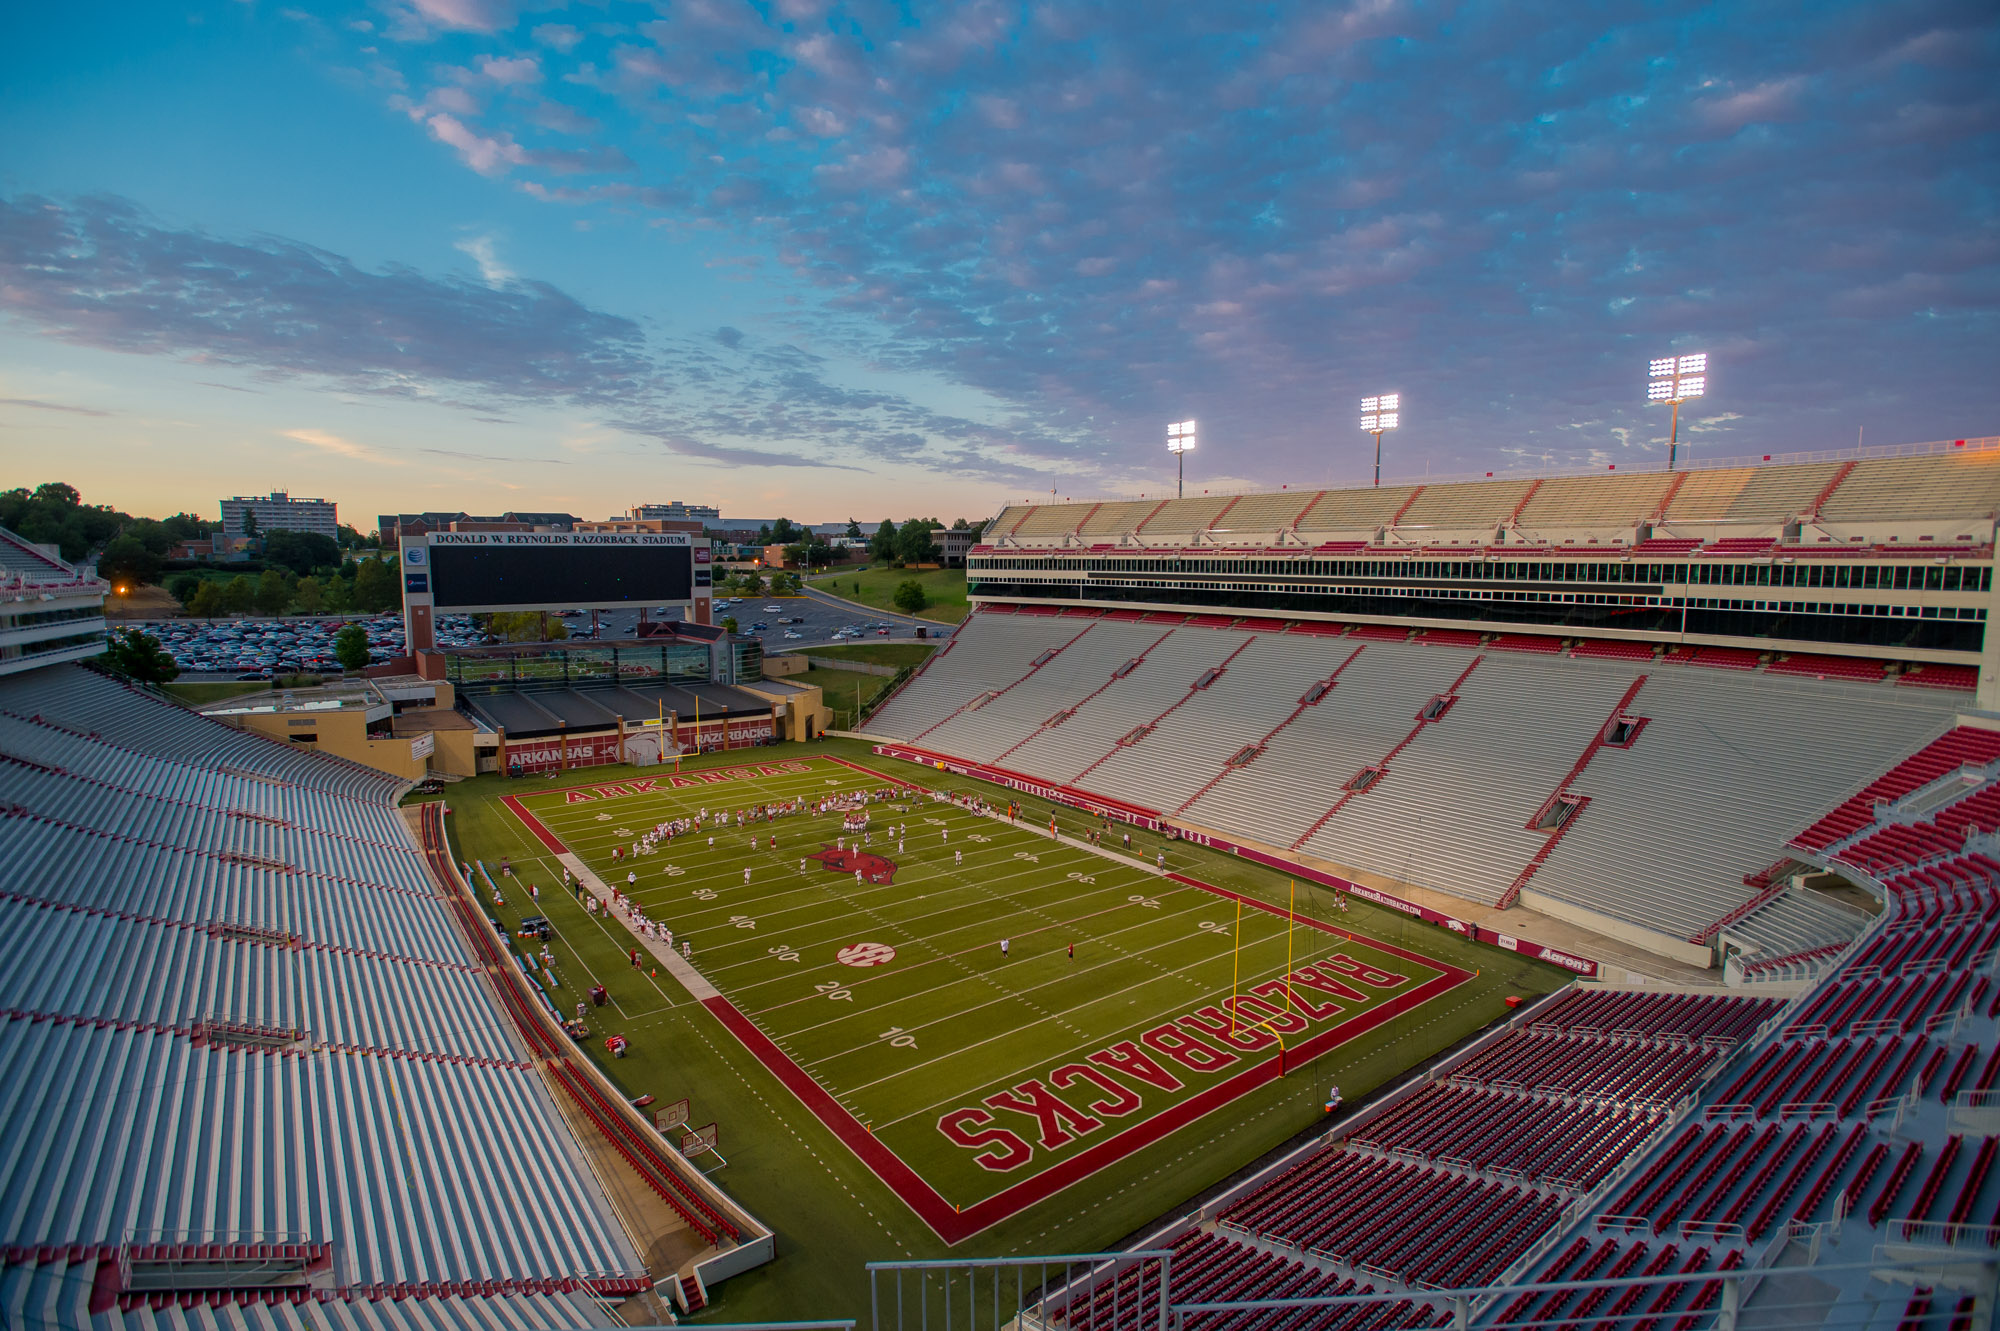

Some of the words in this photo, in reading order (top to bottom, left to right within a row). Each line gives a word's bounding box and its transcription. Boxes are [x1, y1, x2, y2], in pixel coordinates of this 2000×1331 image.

[436, 534, 487, 544] DONALD
[491, 534, 503, 544] W.
[507, 535, 568, 544] REYNOLDS
[573, 535, 638, 545] RAZORBACK
[642, 536, 686, 545] STADIUM
[694, 727, 772, 745] RAZORBACKS
[509, 746, 593, 766] ARKANSAS
[566, 763, 812, 804] ARKANSAS
[1126, 812, 1138, 825] OF
[692, 888, 718, 900] 50
[1128, 895, 1161, 908] 20
[728, 915, 756, 929] 40
[1198, 921, 1228, 934] 10
[768, 945, 799, 961] 30
[1538, 948, 1592, 973] Aaron's
[814, 981, 851, 1000] 20
[879, 1026, 915, 1047] 10
[936, 953, 1411, 1172] RAZORBACKS
